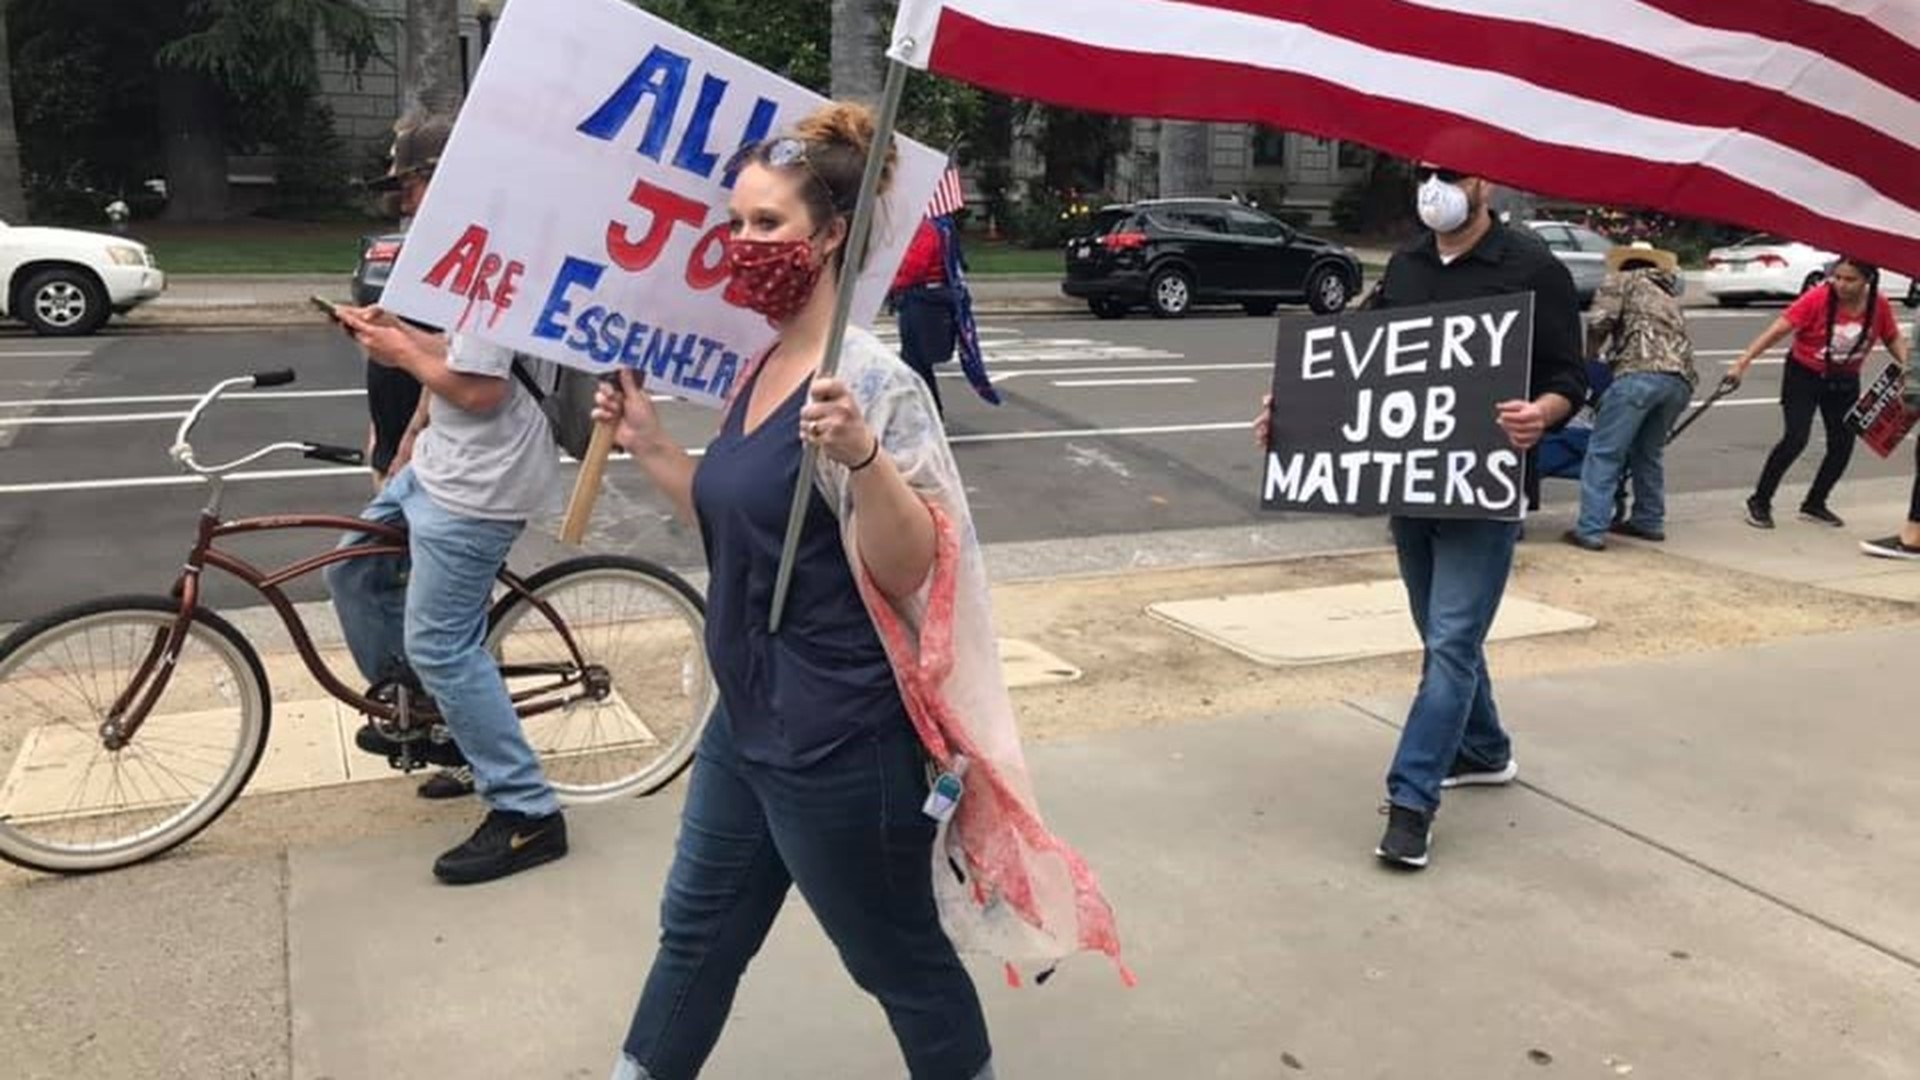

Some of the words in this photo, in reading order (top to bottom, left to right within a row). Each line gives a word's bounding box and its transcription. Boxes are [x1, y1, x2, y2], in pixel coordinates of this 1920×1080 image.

[421, 224, 525, 310] ARE
[605, 178, 732, 290] JO
[1302, 310, 1520, 380] EVERY
[1342, 385, 1457, 443] JOB
[1264, 450, 1519, 510] MATTERS
